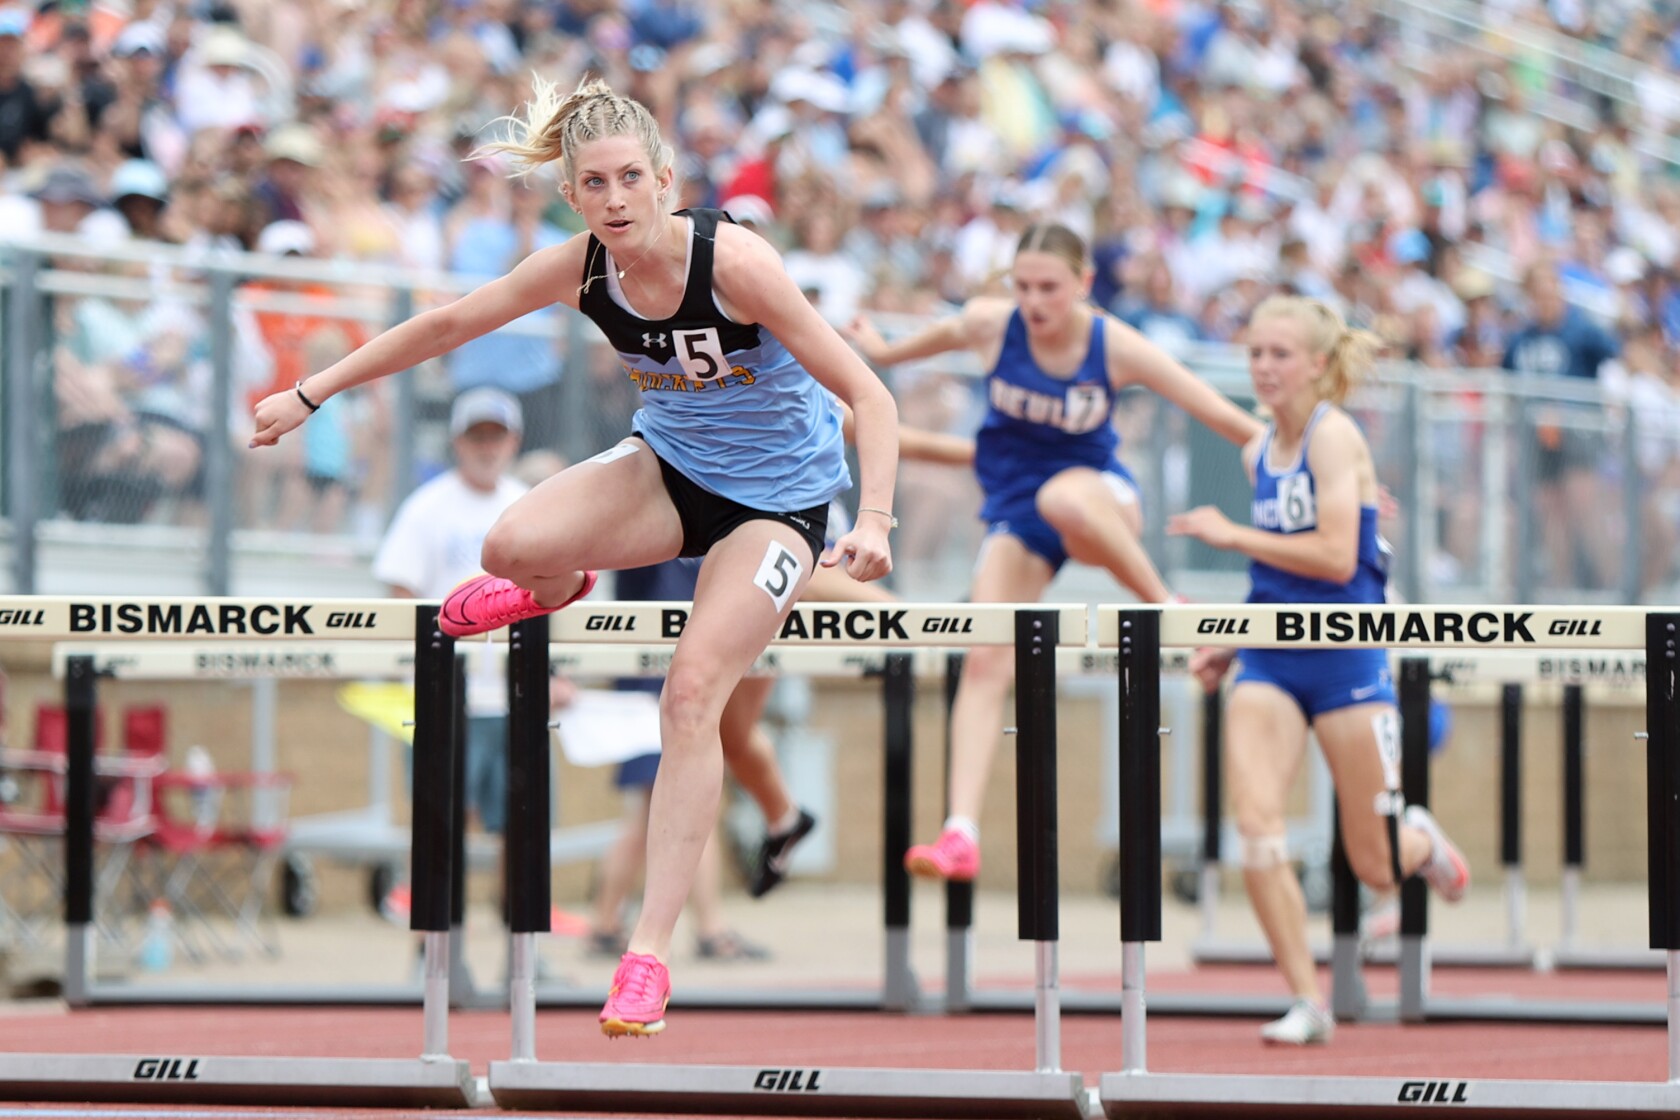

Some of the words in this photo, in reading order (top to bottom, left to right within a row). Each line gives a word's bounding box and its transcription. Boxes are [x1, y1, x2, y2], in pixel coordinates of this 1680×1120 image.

[683, 332, 719, 380] 5
[1286, 478, 1305, 528] 6
[765, 549, 798, 598] 5
[0, 609, 45, 625] GILL
[69, 603, 315, 634] BISMARCK
[325, 612, 377, 629] GILL
[585, 615, 636, 631] GILL
[661, 609, 909, 640] BARCK
[921, 616, 974, 634] GILL
[1197, 618, 1250, 635] GILL
[1276, 612, 1536, 642] BISMARCK
[1548, 619, 1602, 636] GILL
[1539, 657, 1647, 679] BISMAR
[134, 1059, 199, 1079] GILL
[754, 1070, 820, 1091] GILL
[1397, 1082, 1467, 1103] GILL
